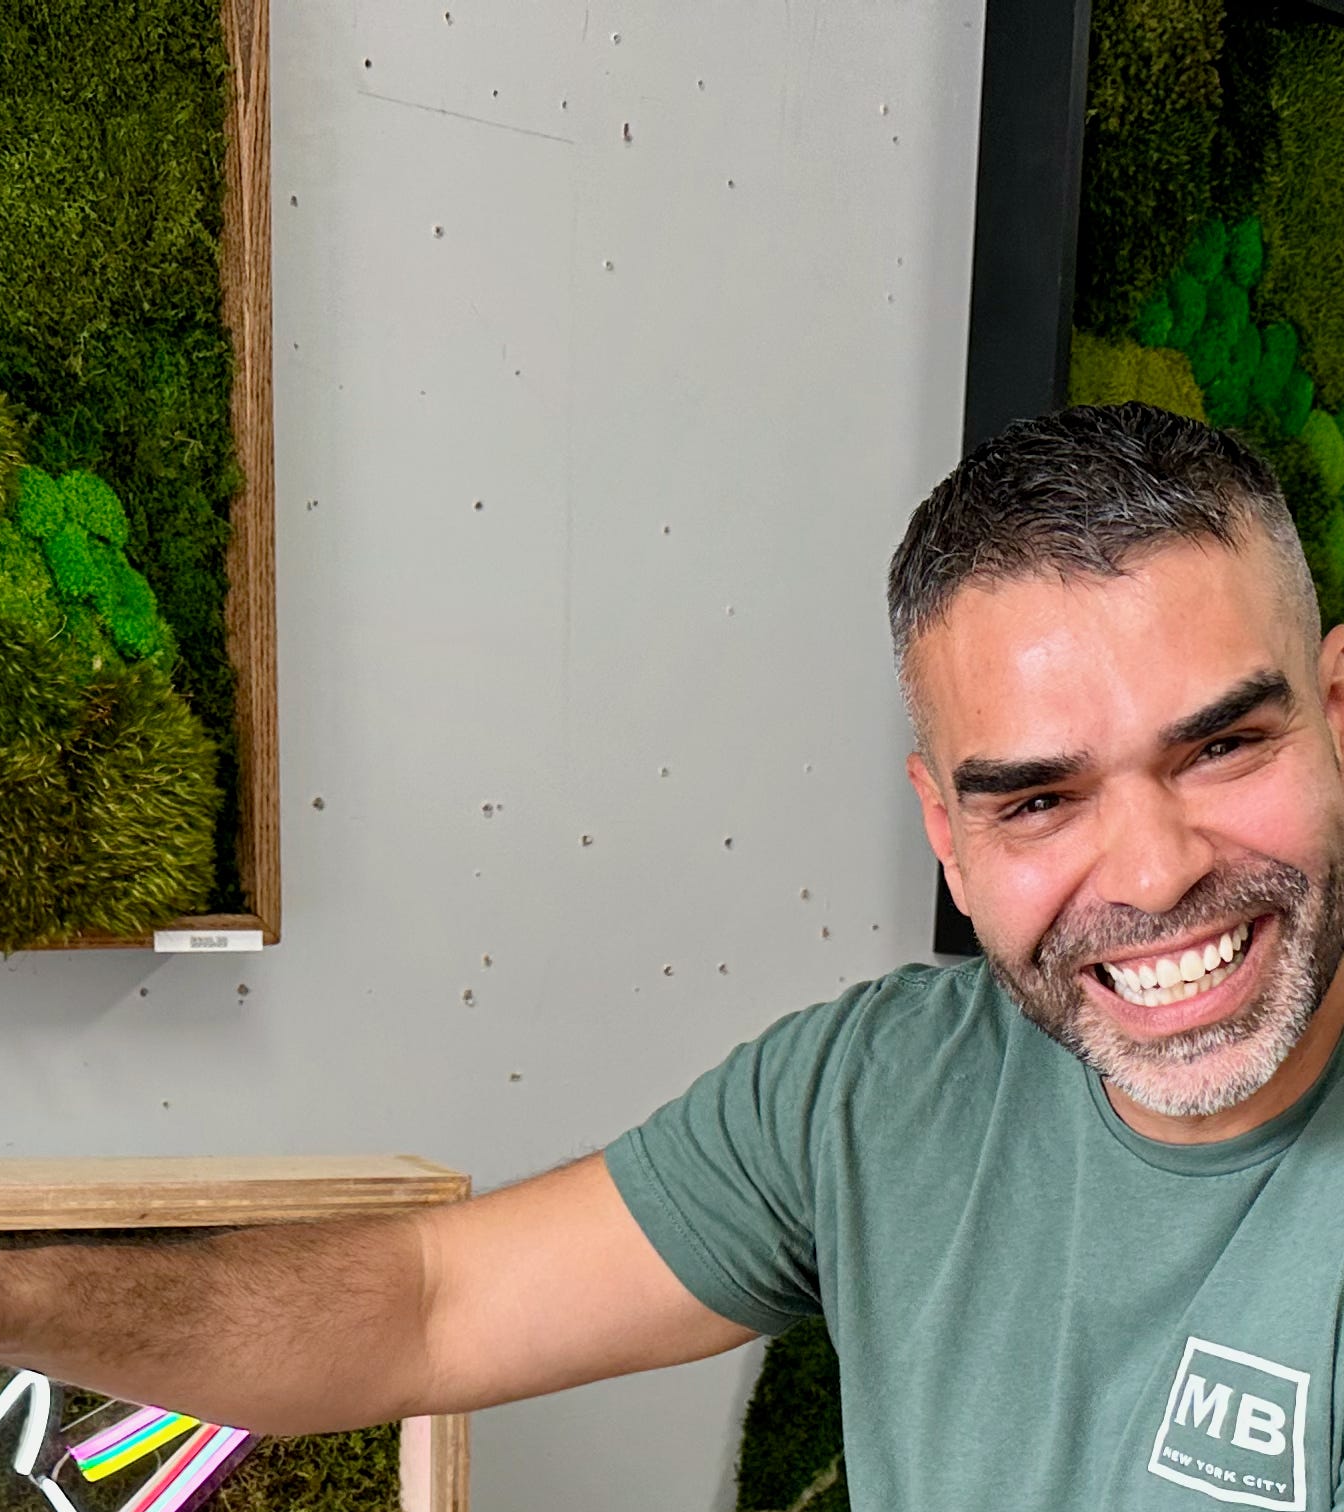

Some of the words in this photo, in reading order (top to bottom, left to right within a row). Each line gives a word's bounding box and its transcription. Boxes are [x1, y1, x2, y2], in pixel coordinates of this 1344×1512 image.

[1173, 1373, 1286, 1456] MB
[1162, 1446, 1194, 1467] NEW
[1196, 1459, 1237, 1483] YORK
[1242, 1474, 1287, 1494] CITY
